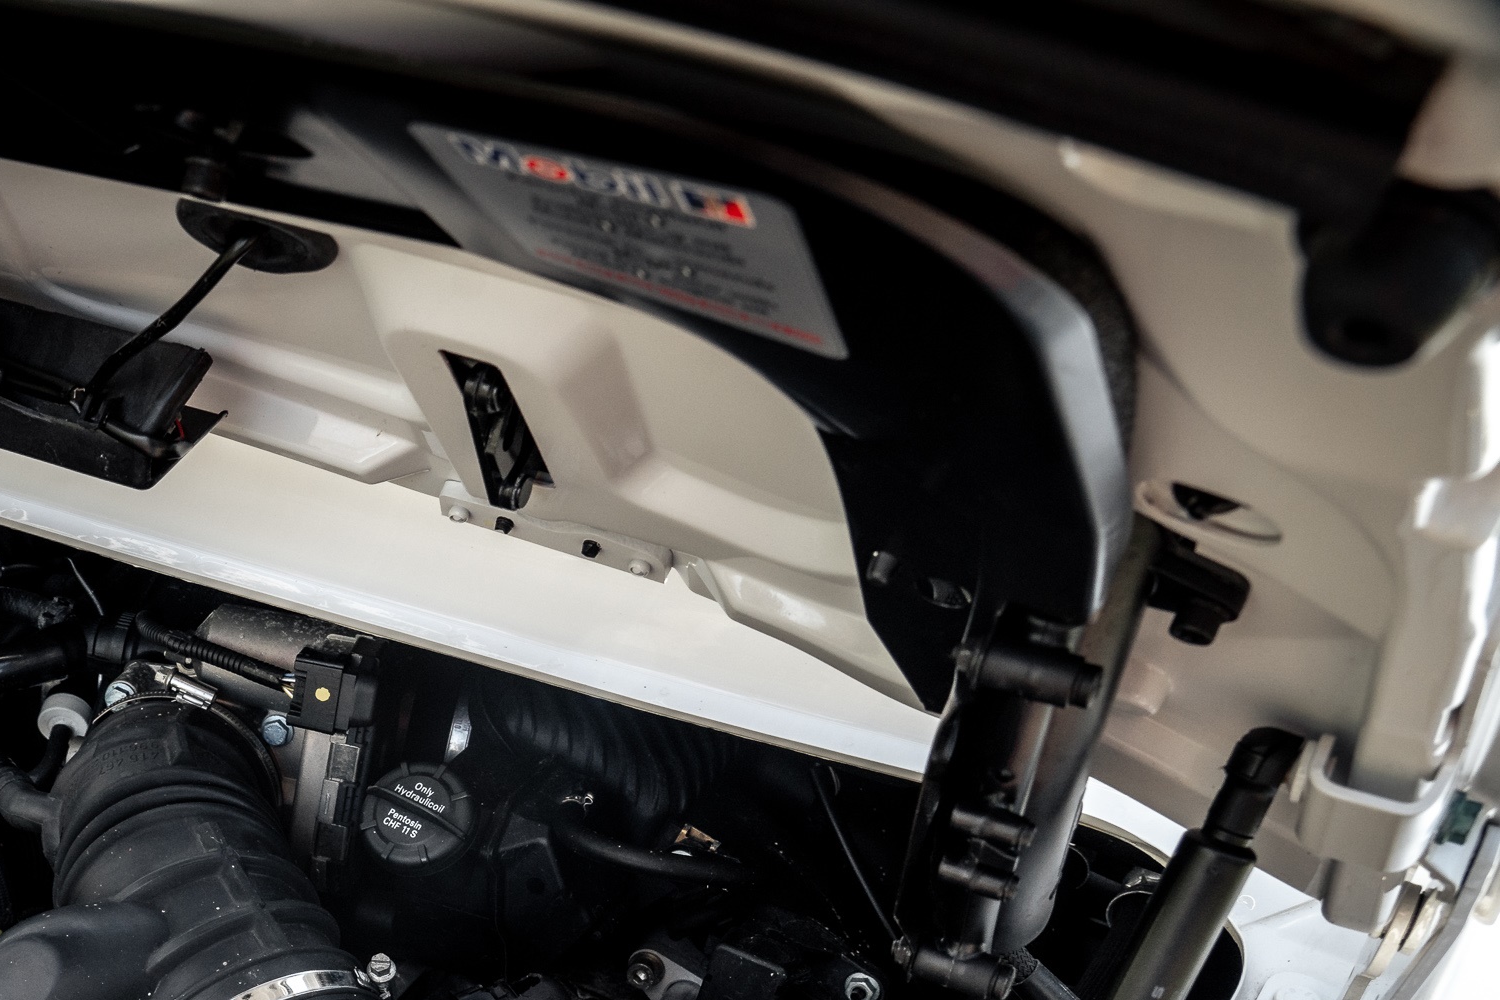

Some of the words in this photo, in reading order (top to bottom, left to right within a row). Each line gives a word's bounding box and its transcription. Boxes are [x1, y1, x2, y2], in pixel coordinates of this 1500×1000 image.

[447, 131, 672, 209] Mobil
[394, 783, 446, 814] Hydraulicoil
[414, 782, 435, 797] Only
[383, 816, 402, 830] CHF
[401, 825, 410, 836] 11
[409, 829, 419, 839] S
[387, 808, 423, 831] Pentosin
